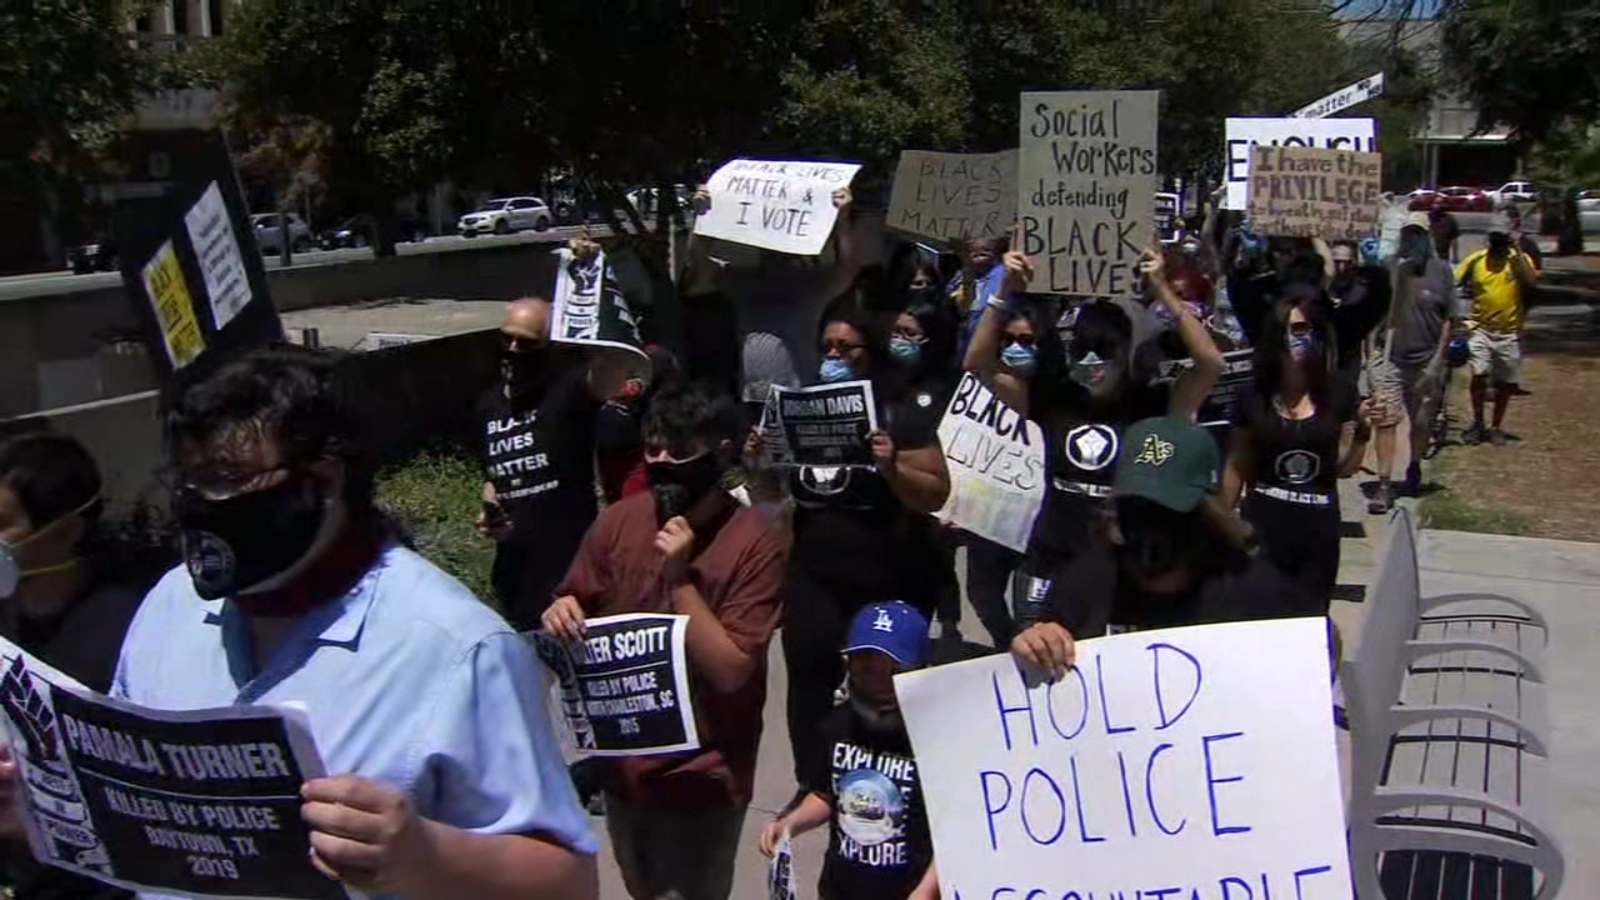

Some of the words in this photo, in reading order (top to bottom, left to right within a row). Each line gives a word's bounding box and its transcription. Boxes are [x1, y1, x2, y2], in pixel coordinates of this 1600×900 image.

[1030, 99, 1119, 138] Social
[920, 160, 1003, 182] BLACK
[1051, 140, 1155, 177] Workers
[1278, 149, 1332, 174] have
[1336, 152, 1379, 177] the
[797, 166, 846, 183] LIVES
[1252, 175, 1381, 205] PRIVILEGE
[726, 175, 789, 200] MATTER
[802, 188, 814, 207] &
[917, 180, 1002, 208] LIVES
[1031, 178, 1130, 220] defending
[736, 202, 754, 226] I
[762, 205, 813, 237] VOTE
[901, 209, 1001, 239] MATTER
[1022, 215, 1142, 261] BLACK
[825, 394, 864, 416] DAVIS
[950, 374, 1031, 446] BLACK
[488, 431, 535, 456] LIVES
[946, 426, 1043, 491] LIVES
[873, 609, 893, 632] LA
[614, 626, 668, 660] SCOTT
[621, 671, 657, 692] POLICE
[993, 643, 1203, 751] HOLD
[165, 742, 291, 779] TURNER
[980, 732, 1252, 850] POLICE
[104, 786, 169, 822] KILLED
[168, 799, 200, 829] BY
[199, 805, 281, 831] POLICE
[232, 836, 260, 856] TX
[838, 839, 907, 867] XPLORE
[186, 855, 239, 879] 2019
